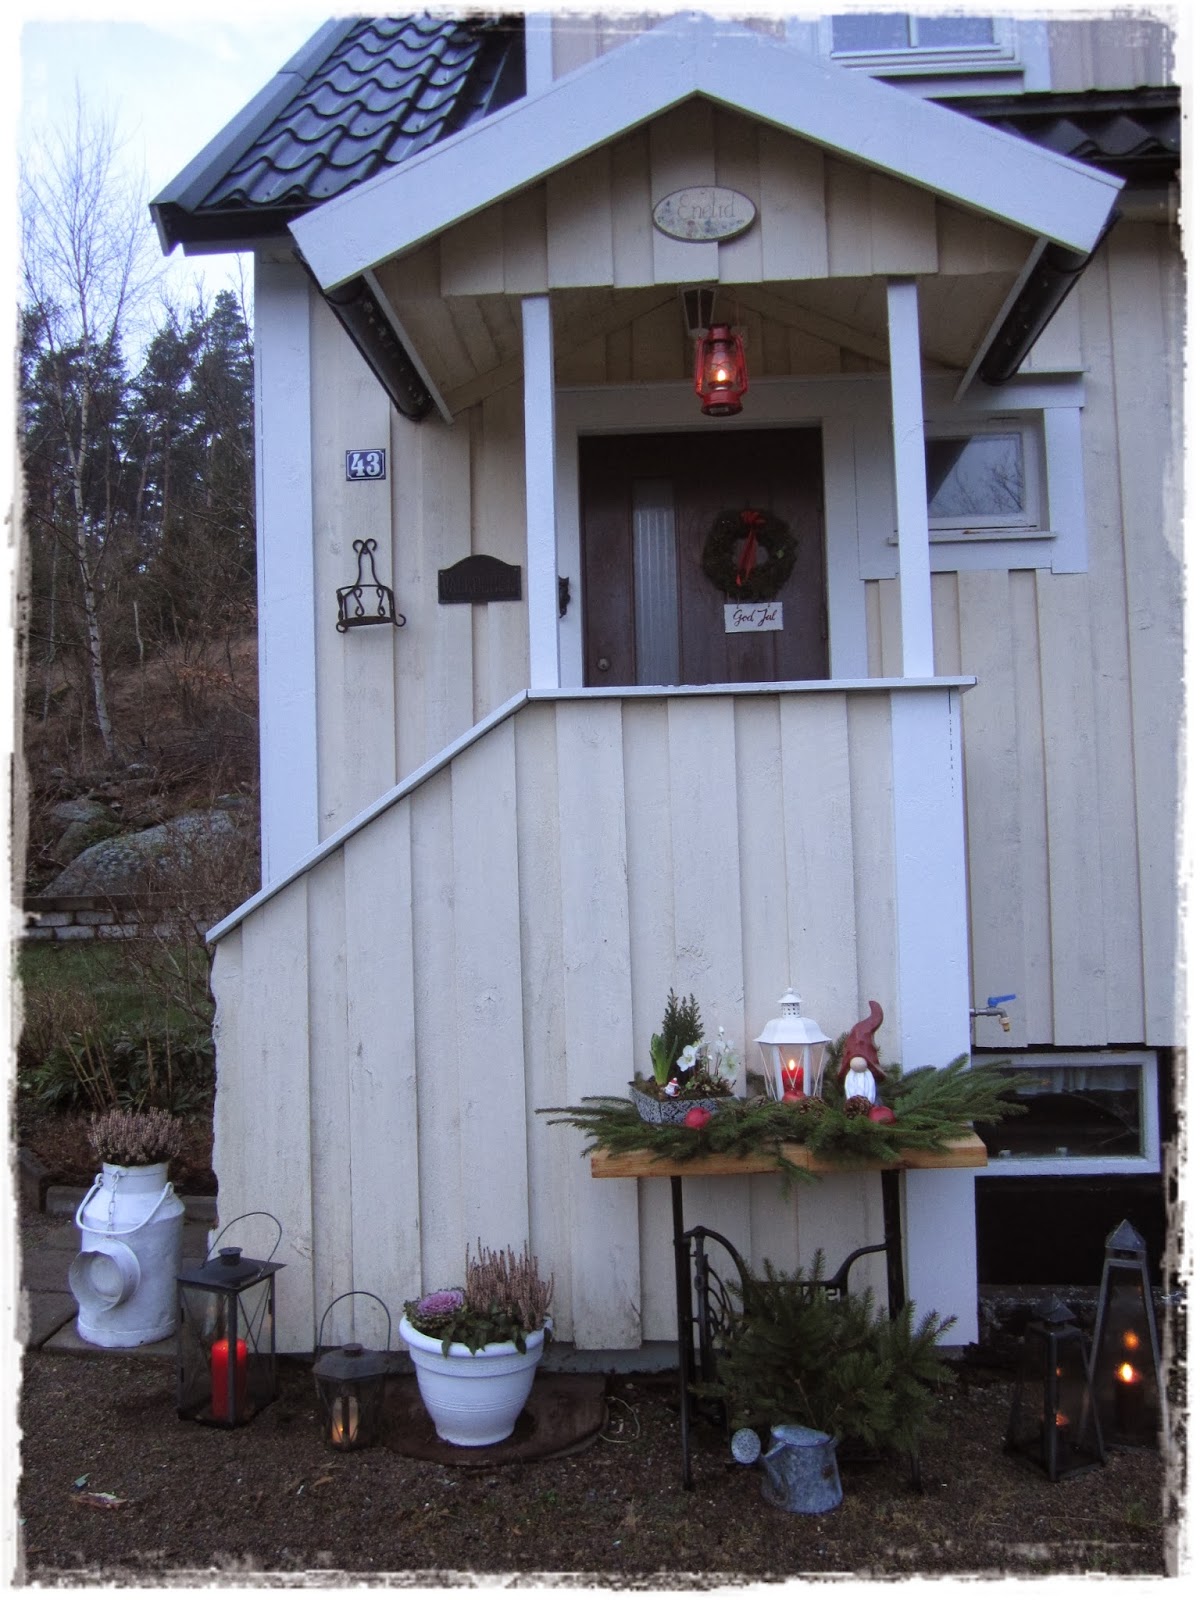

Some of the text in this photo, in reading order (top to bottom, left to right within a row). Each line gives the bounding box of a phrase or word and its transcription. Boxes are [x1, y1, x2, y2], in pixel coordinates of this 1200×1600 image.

[350, 452, 380, 476] 43
[733, 608, 777, 627] God Jul
